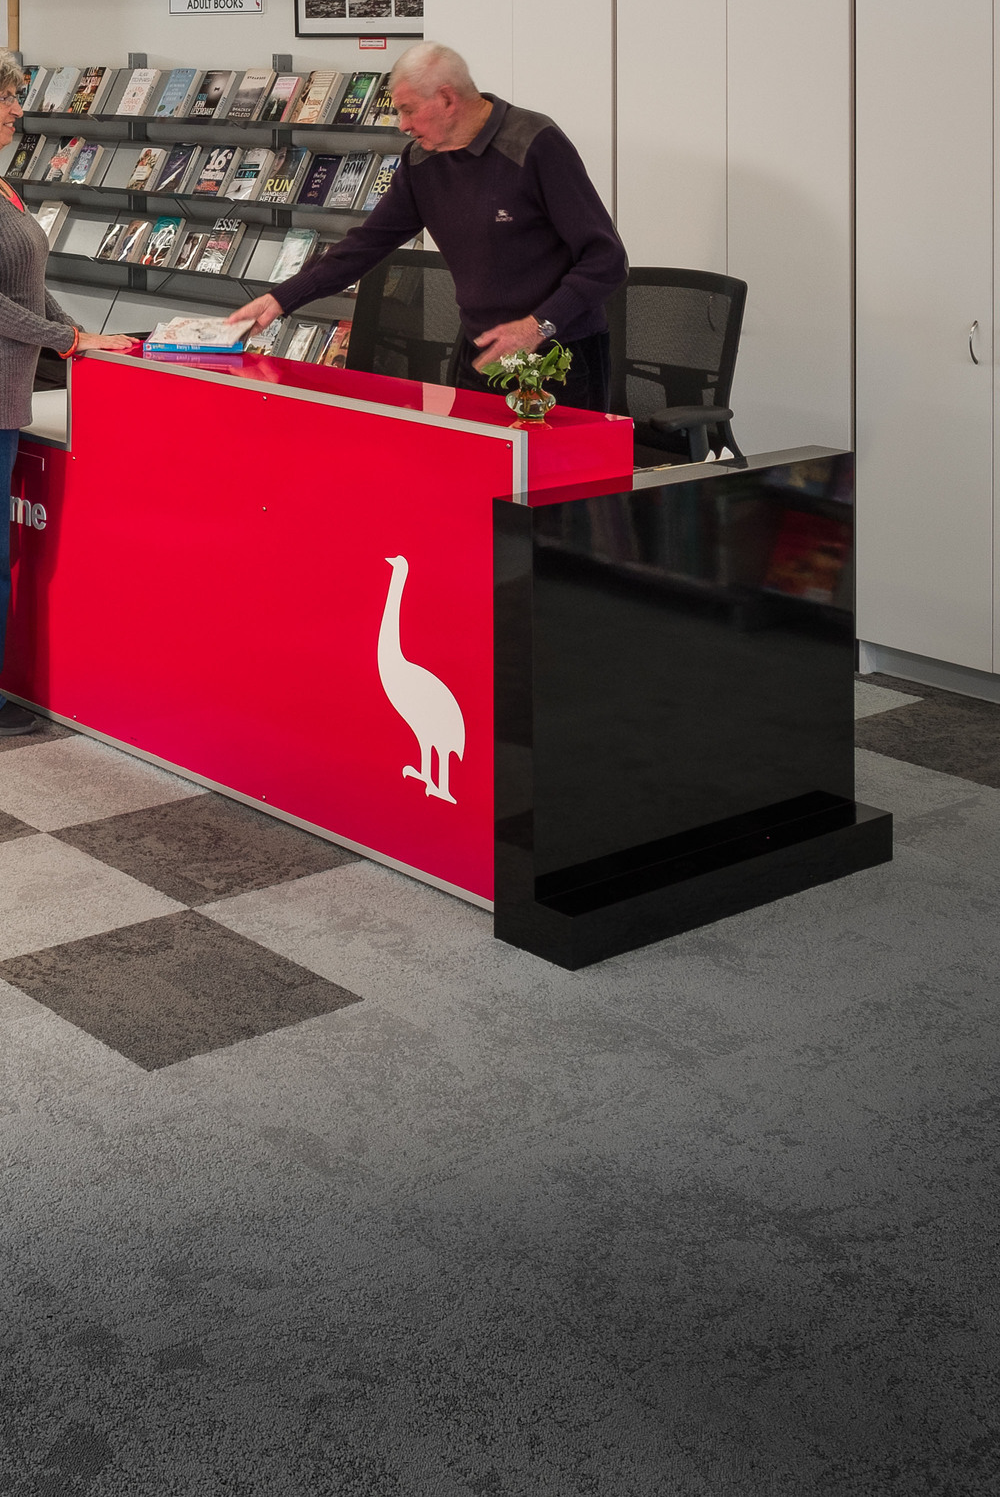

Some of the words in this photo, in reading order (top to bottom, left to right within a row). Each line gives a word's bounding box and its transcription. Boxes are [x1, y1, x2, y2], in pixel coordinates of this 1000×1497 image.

[187, 0, 212, 10] ADULT
[24, 134, 37, 143] TEN
[18, 143, 36, 152] DAYS
[264, 179, 293, 192] RUN
